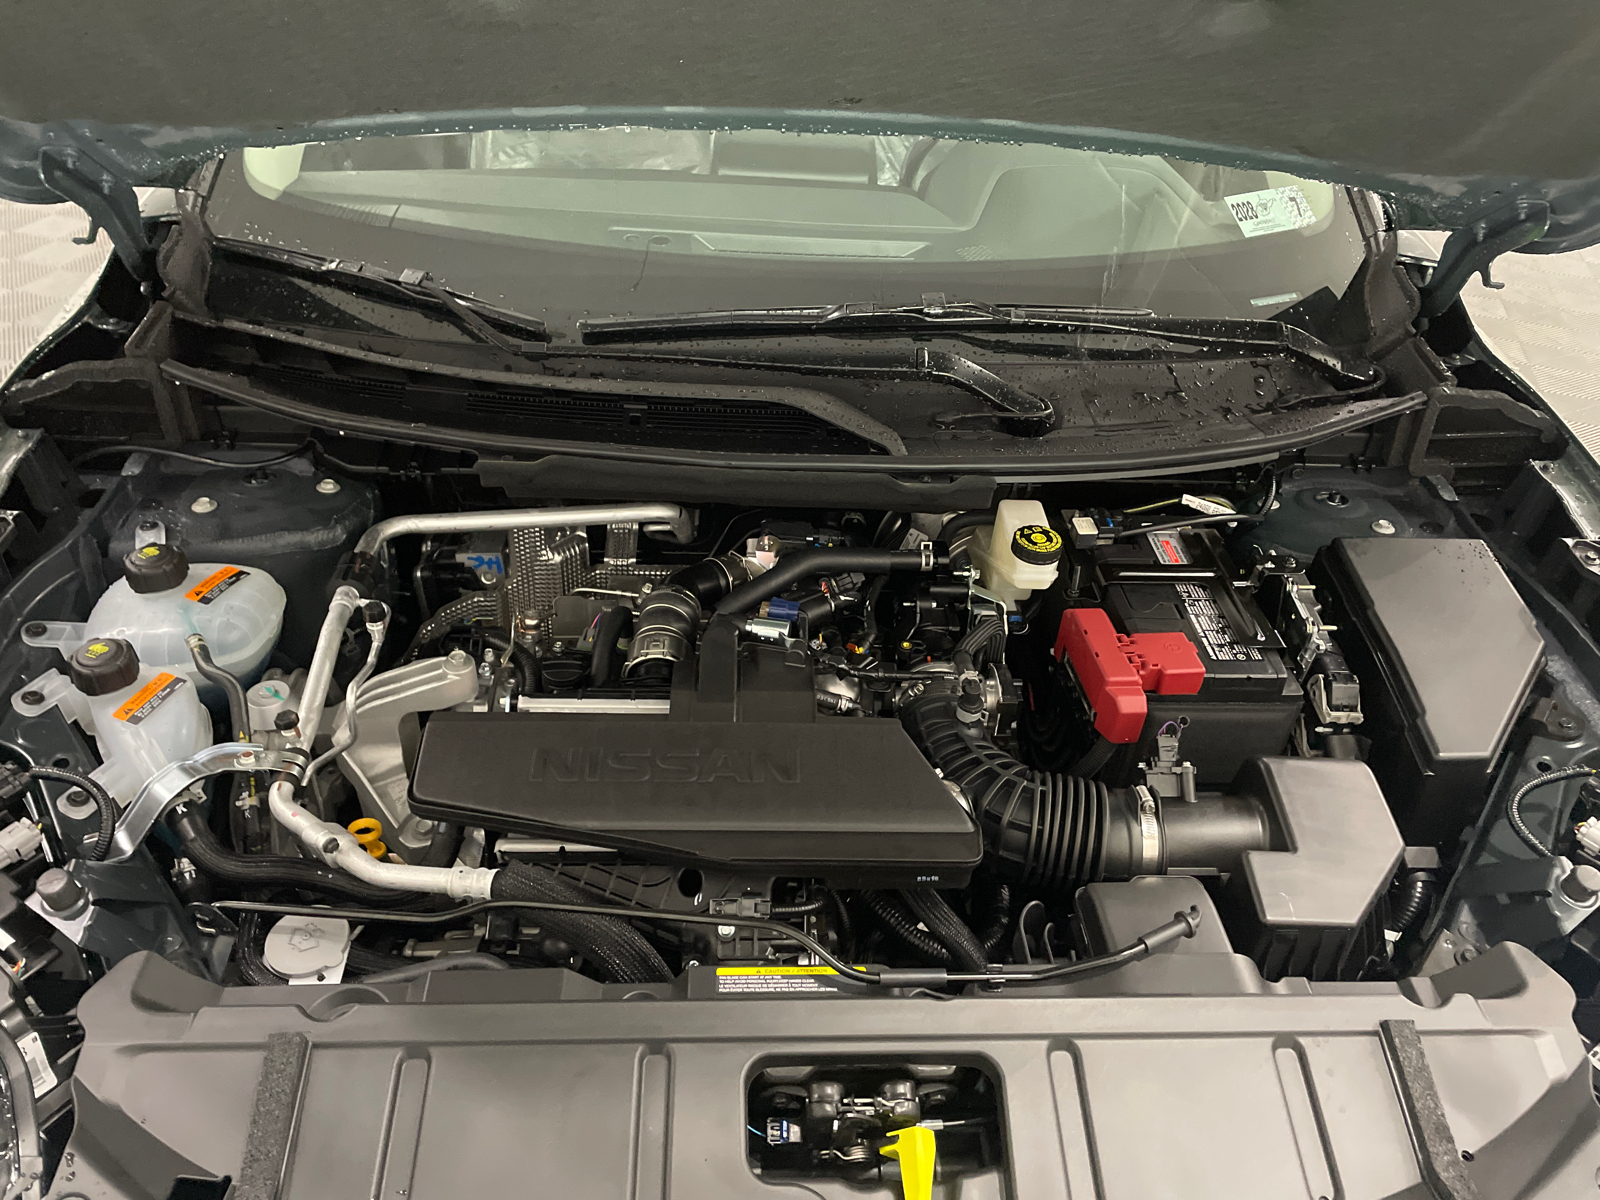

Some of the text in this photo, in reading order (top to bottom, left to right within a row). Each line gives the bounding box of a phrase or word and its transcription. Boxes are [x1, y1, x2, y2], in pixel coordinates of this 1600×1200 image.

[1231, 201, 1258, 222] 2028
[1288, 197, 1302, 218] 7
[529, 748, 800, 783] NISSAN
